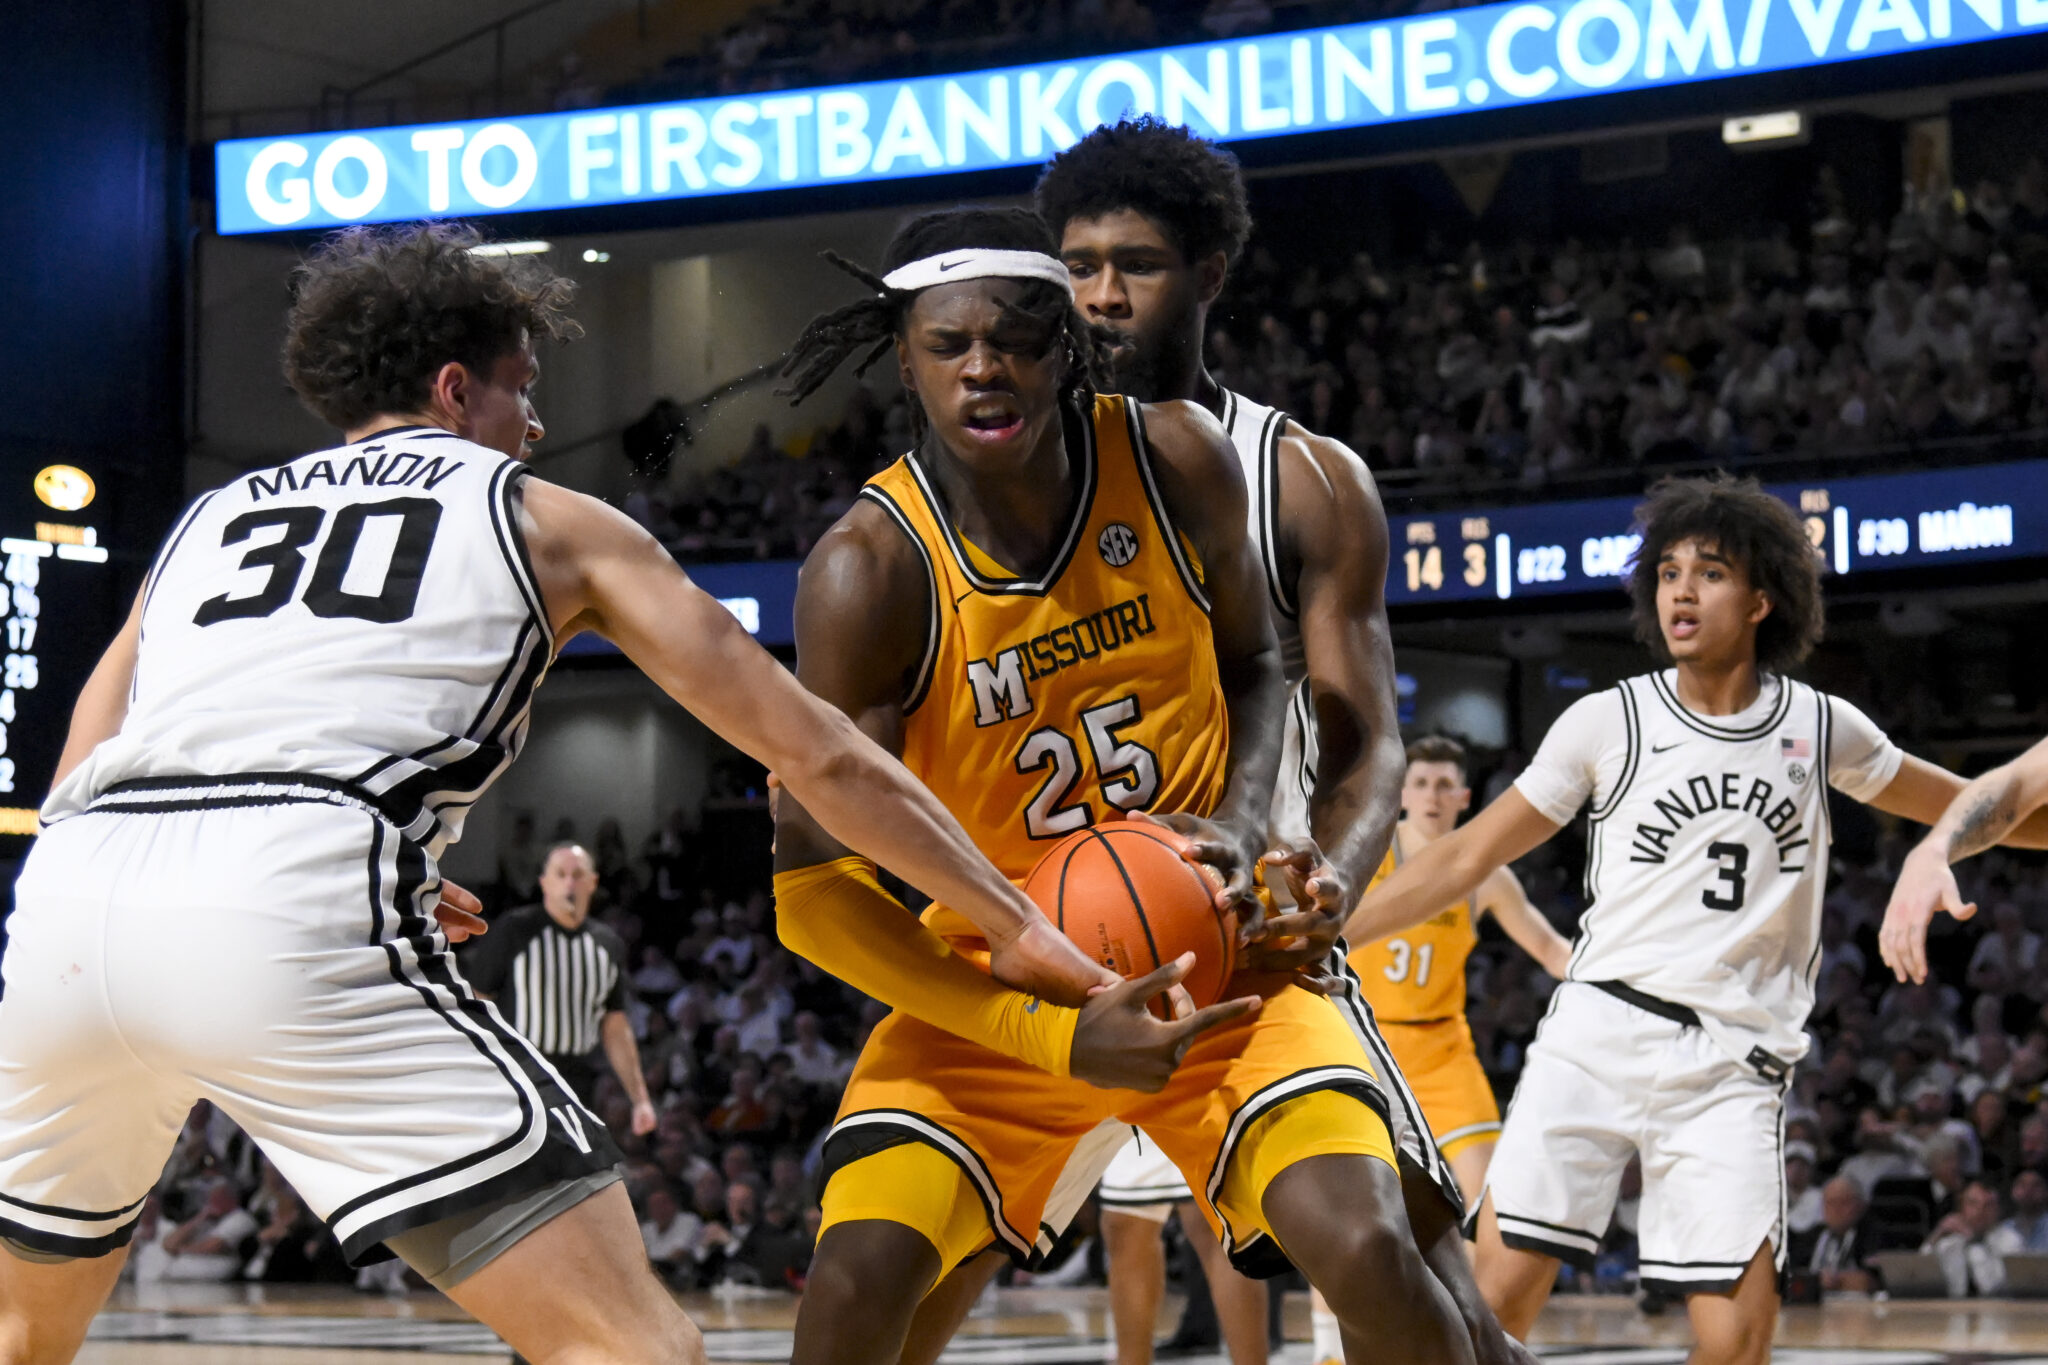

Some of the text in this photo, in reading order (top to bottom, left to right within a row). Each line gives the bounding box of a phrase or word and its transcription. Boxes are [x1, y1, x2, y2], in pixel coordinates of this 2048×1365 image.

[245, 0, 2048, 225] GO TO FIRSTBANKONLINE.COM/VAN
[247, 445, 465, 502] MAÑON
[192, 496, 444, 628] 30
[1099, 524, 1138, 567] SEC
[1404, 546, 1444, 591] 14
[1463, 543, 1487, 587] 3
[967, 594, 1156, 728] MISSOURI
[1014, 693, 1162, 841] 25
[1702, 841, 1749, 912] 3
[1384, 938, 1433, 988] 31
